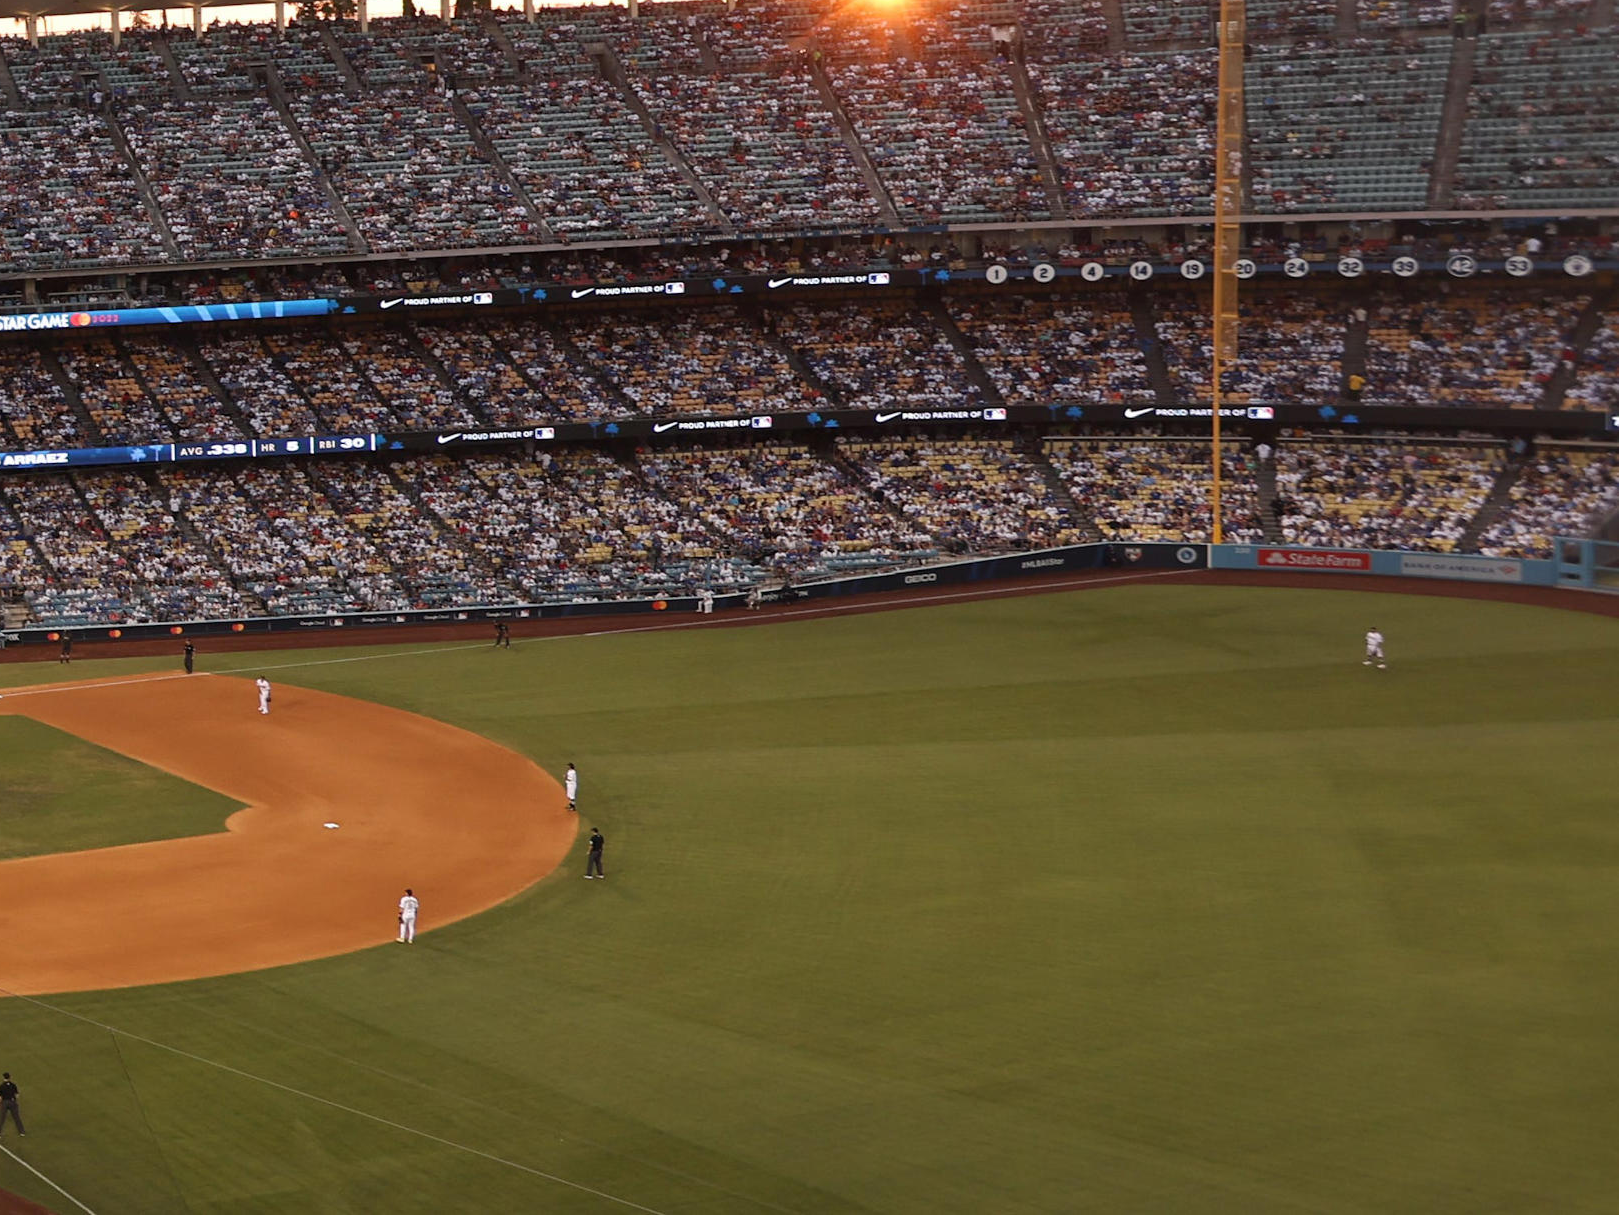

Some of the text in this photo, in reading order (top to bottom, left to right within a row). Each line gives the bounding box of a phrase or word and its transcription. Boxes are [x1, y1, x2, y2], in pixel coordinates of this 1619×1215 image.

[793, 277, 820, 285] PROUD
[821, 276, 855, 284] PARTNER
[595, 287, 620, 295] PROUD
[621, 286, 653, 294] PARTNER
[902, 412, 931, 420] PROUD
[932, 411, 969, 419] PARTNER
[1155, 408, 1188, 416] PROUD
[1189, 408, 1231, 416] PARTER
[462, 433, 489, 441] PROUD
[489, 431, 522, 439] PARTNER
[180, 447, 203, 456] AVG
[261, 443, 276, 452] HR
[286, 441, 299, 451] 5
[319, 440, 336, 449] RBI
[340, 438, 365, 448] 30
[3, 453, 69, 466] ARRAEZ
[904, 573, 937, 584] GEICO
